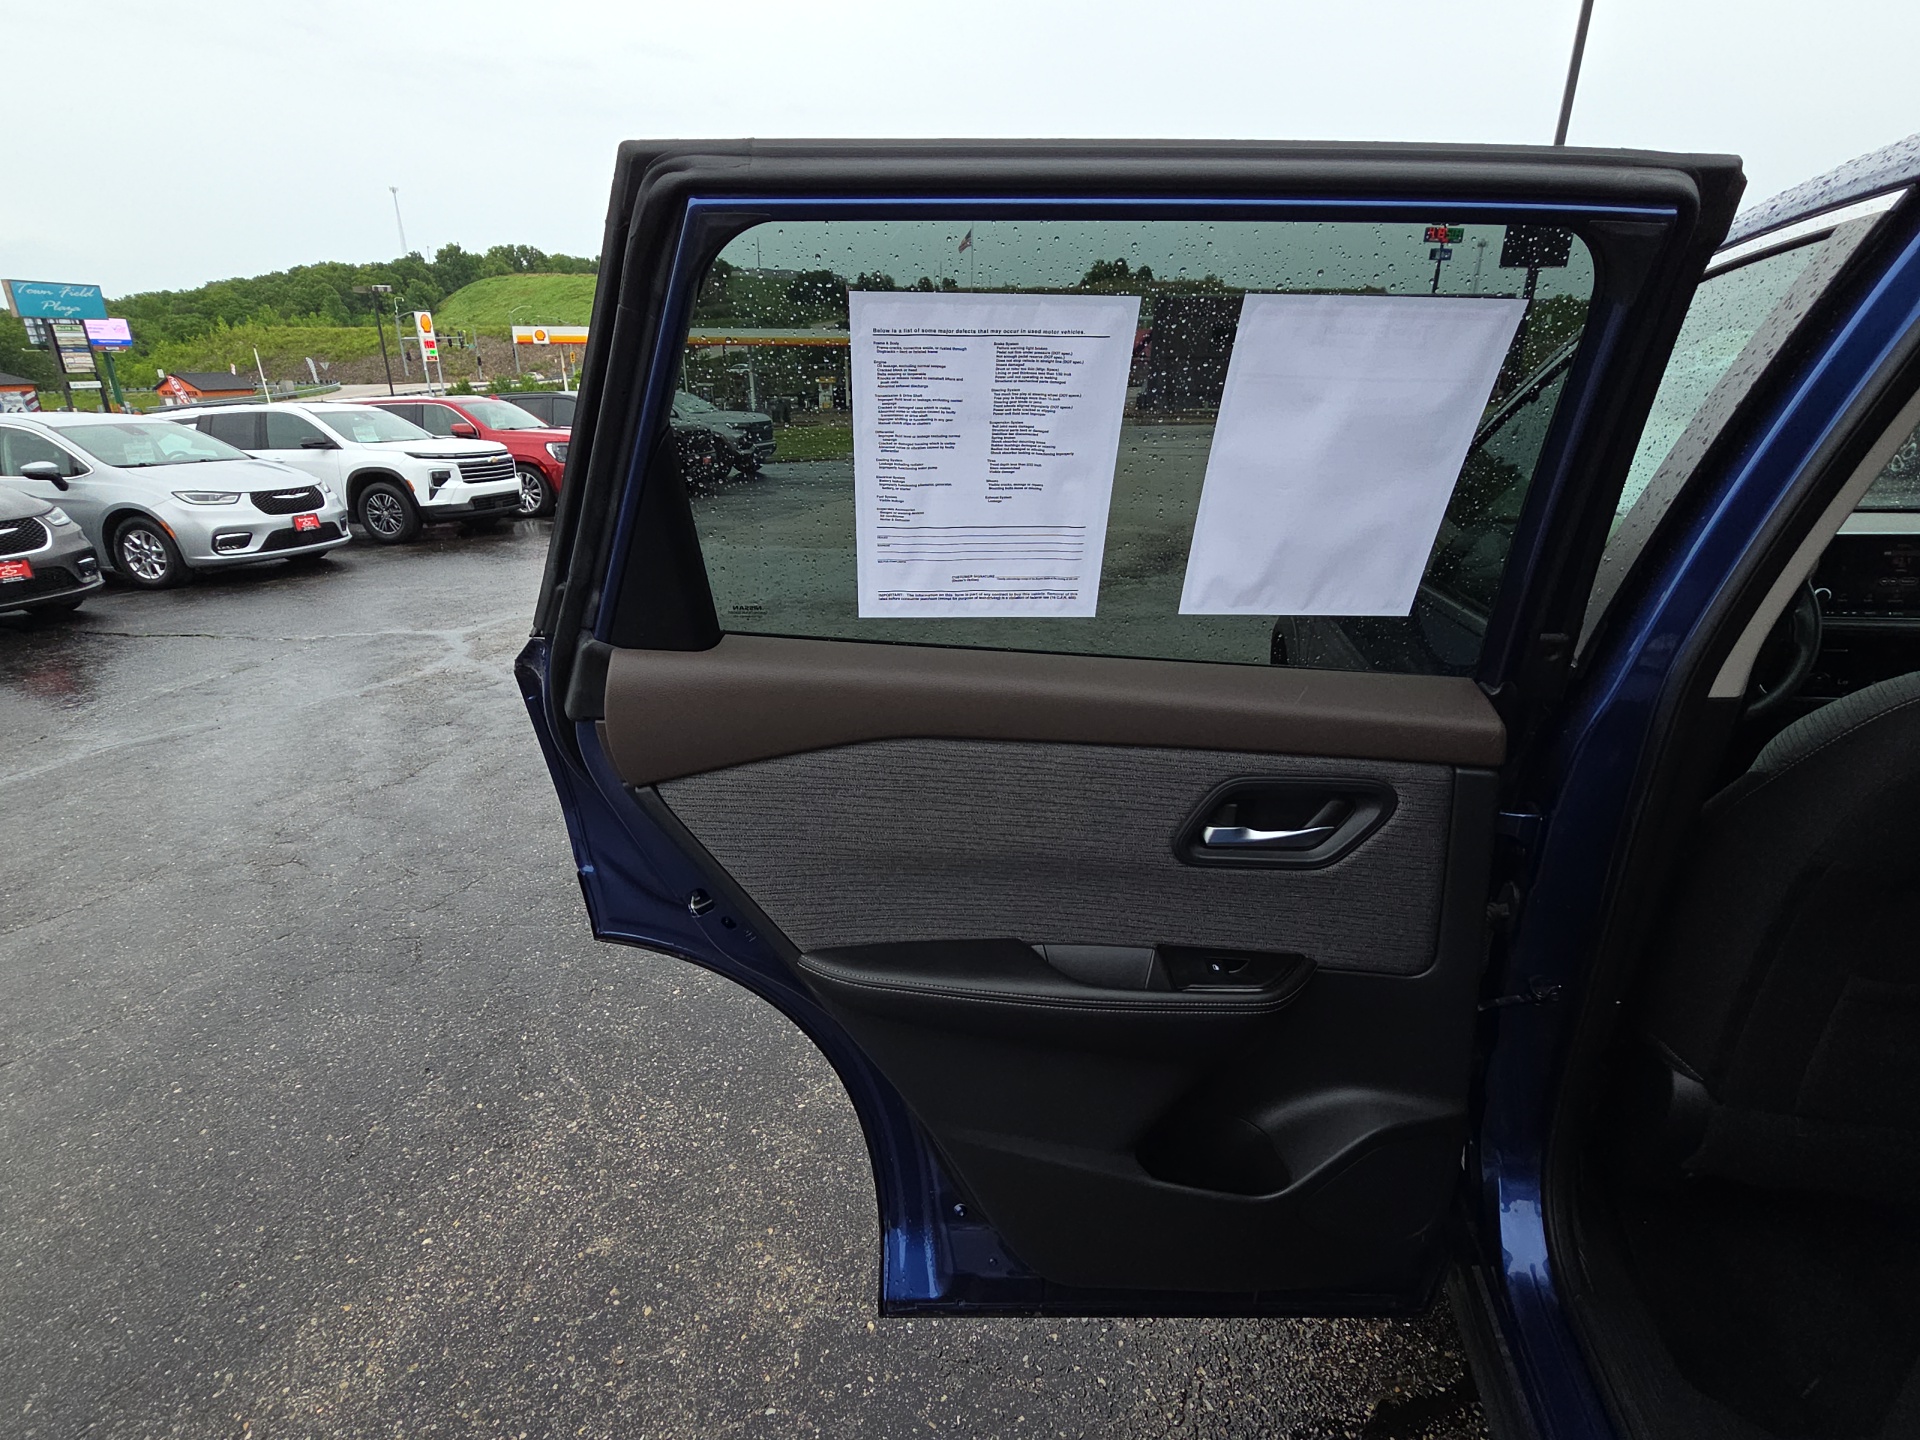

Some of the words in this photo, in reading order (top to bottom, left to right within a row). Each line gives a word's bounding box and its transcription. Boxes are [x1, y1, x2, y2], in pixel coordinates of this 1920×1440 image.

[16, 283, 53, 295] Town
[59, 286, 95, 298] Field
[42, 300, 81, 316] Plaza
